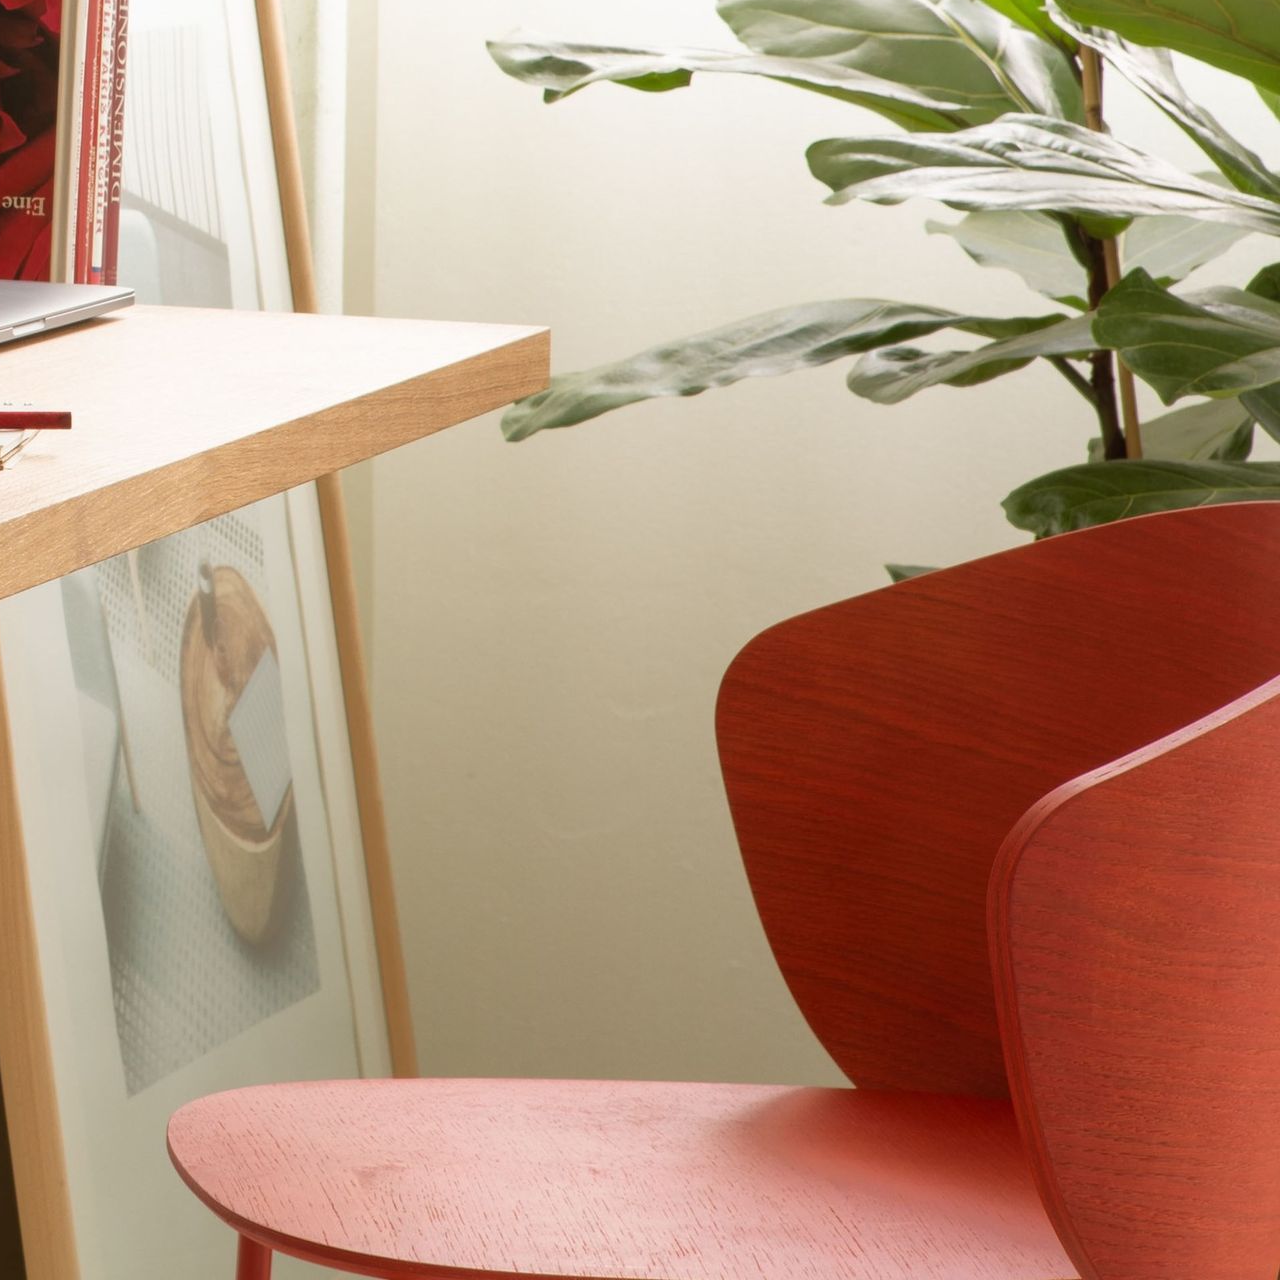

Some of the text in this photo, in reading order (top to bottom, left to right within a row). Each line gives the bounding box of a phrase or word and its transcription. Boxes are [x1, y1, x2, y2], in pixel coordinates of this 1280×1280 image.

[100, 51, 109, 113] PARIS
[2, 196, 46, 216] Eine
[95, 126, 106, 233] KITCHEN
